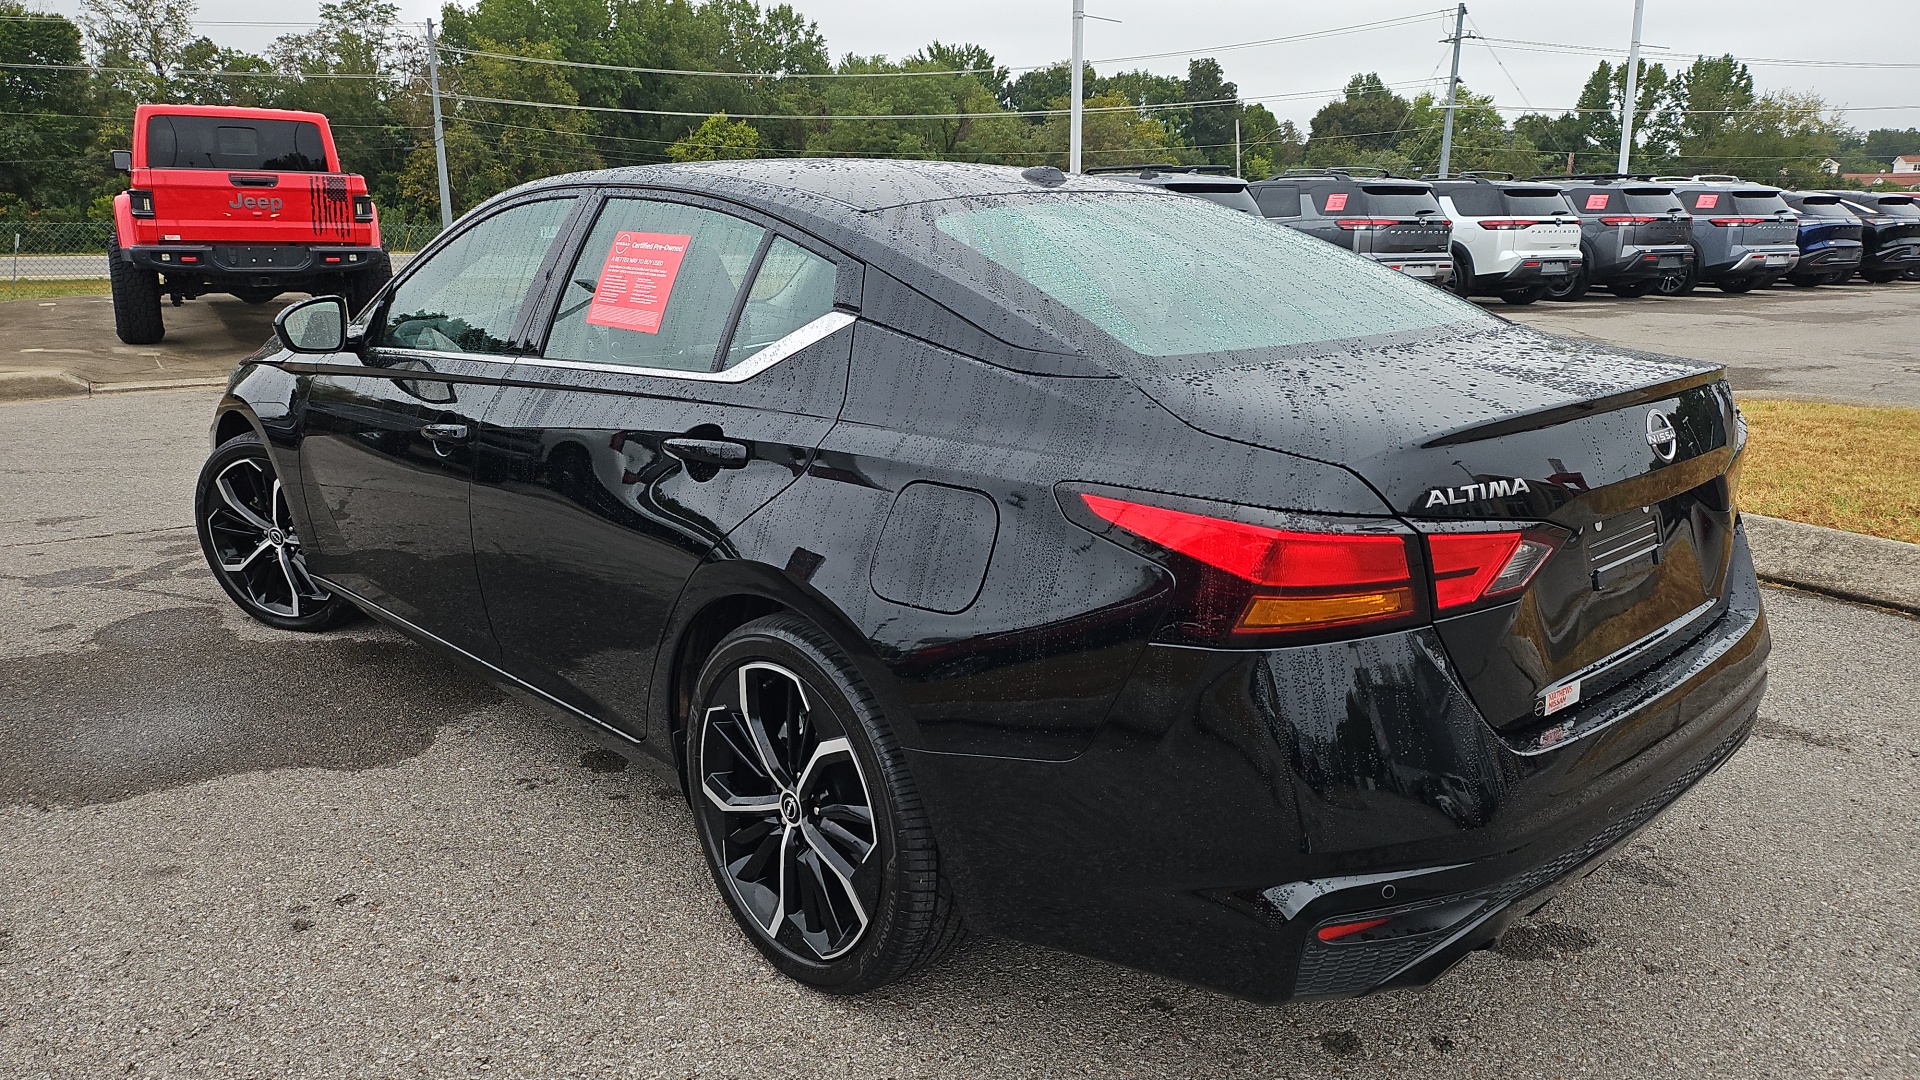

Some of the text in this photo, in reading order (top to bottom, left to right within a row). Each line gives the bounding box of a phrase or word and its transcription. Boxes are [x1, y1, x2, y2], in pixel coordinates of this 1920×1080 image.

[229, 193, 283, 212] Jeep
[631, 241, 684, 252] Certified Pre-Owned
[1425, 477, 1530, 508] ALTIMA
[872, 889, 897, 958] TURANZA
